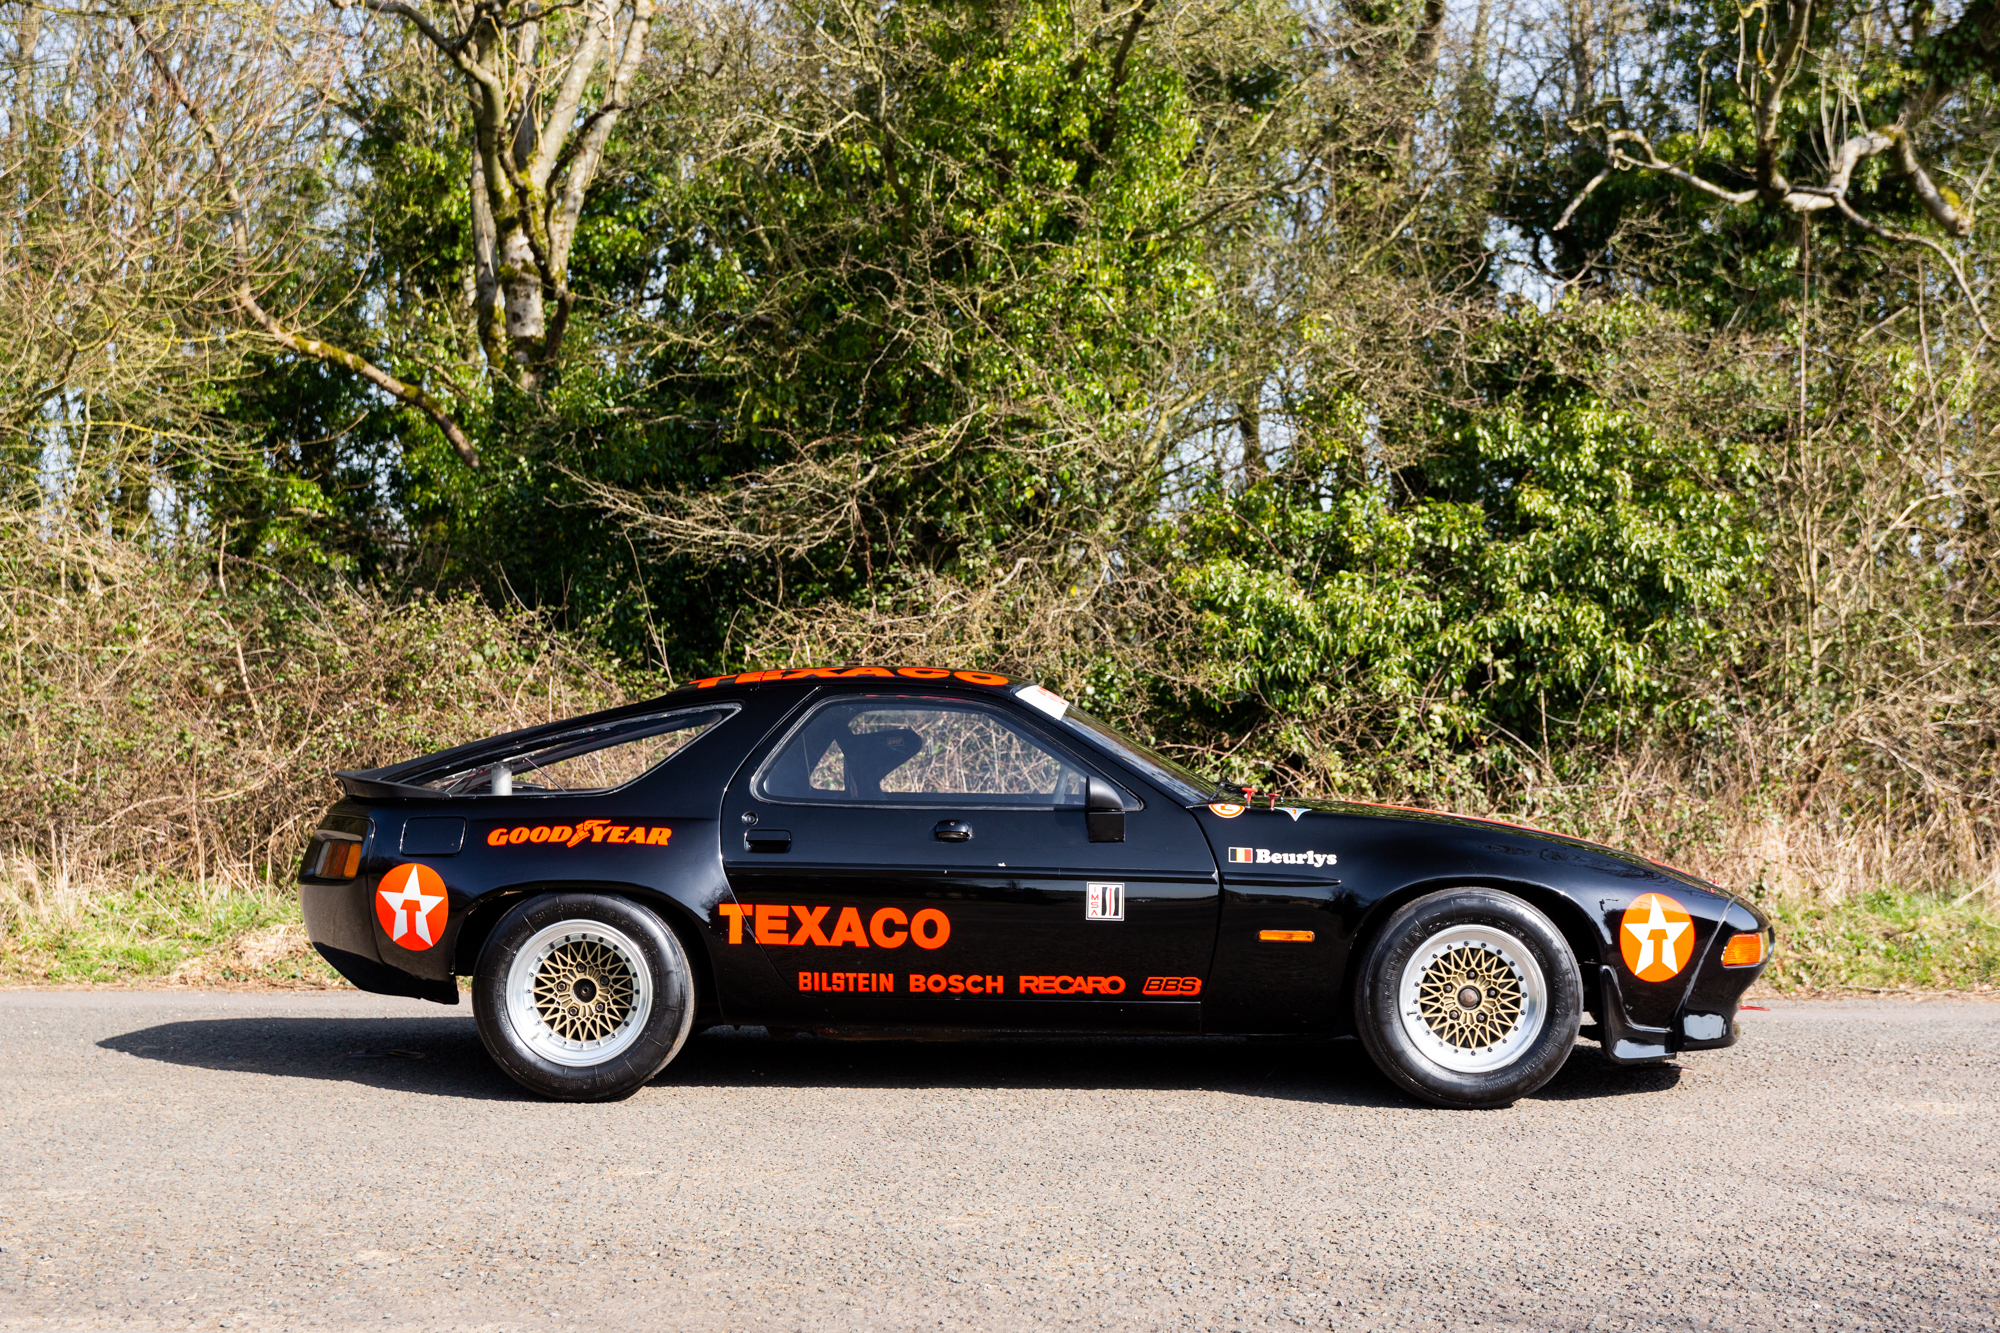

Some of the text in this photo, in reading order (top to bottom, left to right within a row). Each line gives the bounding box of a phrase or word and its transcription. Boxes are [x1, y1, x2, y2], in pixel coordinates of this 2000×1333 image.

[688, 666, 1009, 690] TEXACO
[487, 822, 672, 848] GOODYEAR
[1255, 848, 1337, 868] Beurlys
[1090, 886, 1100, 916] IMSA
[719, 904, 951, 949] TEXACO
[798, 971, 1203, 996] BILSTEIN BOSCH RECARO BBS
